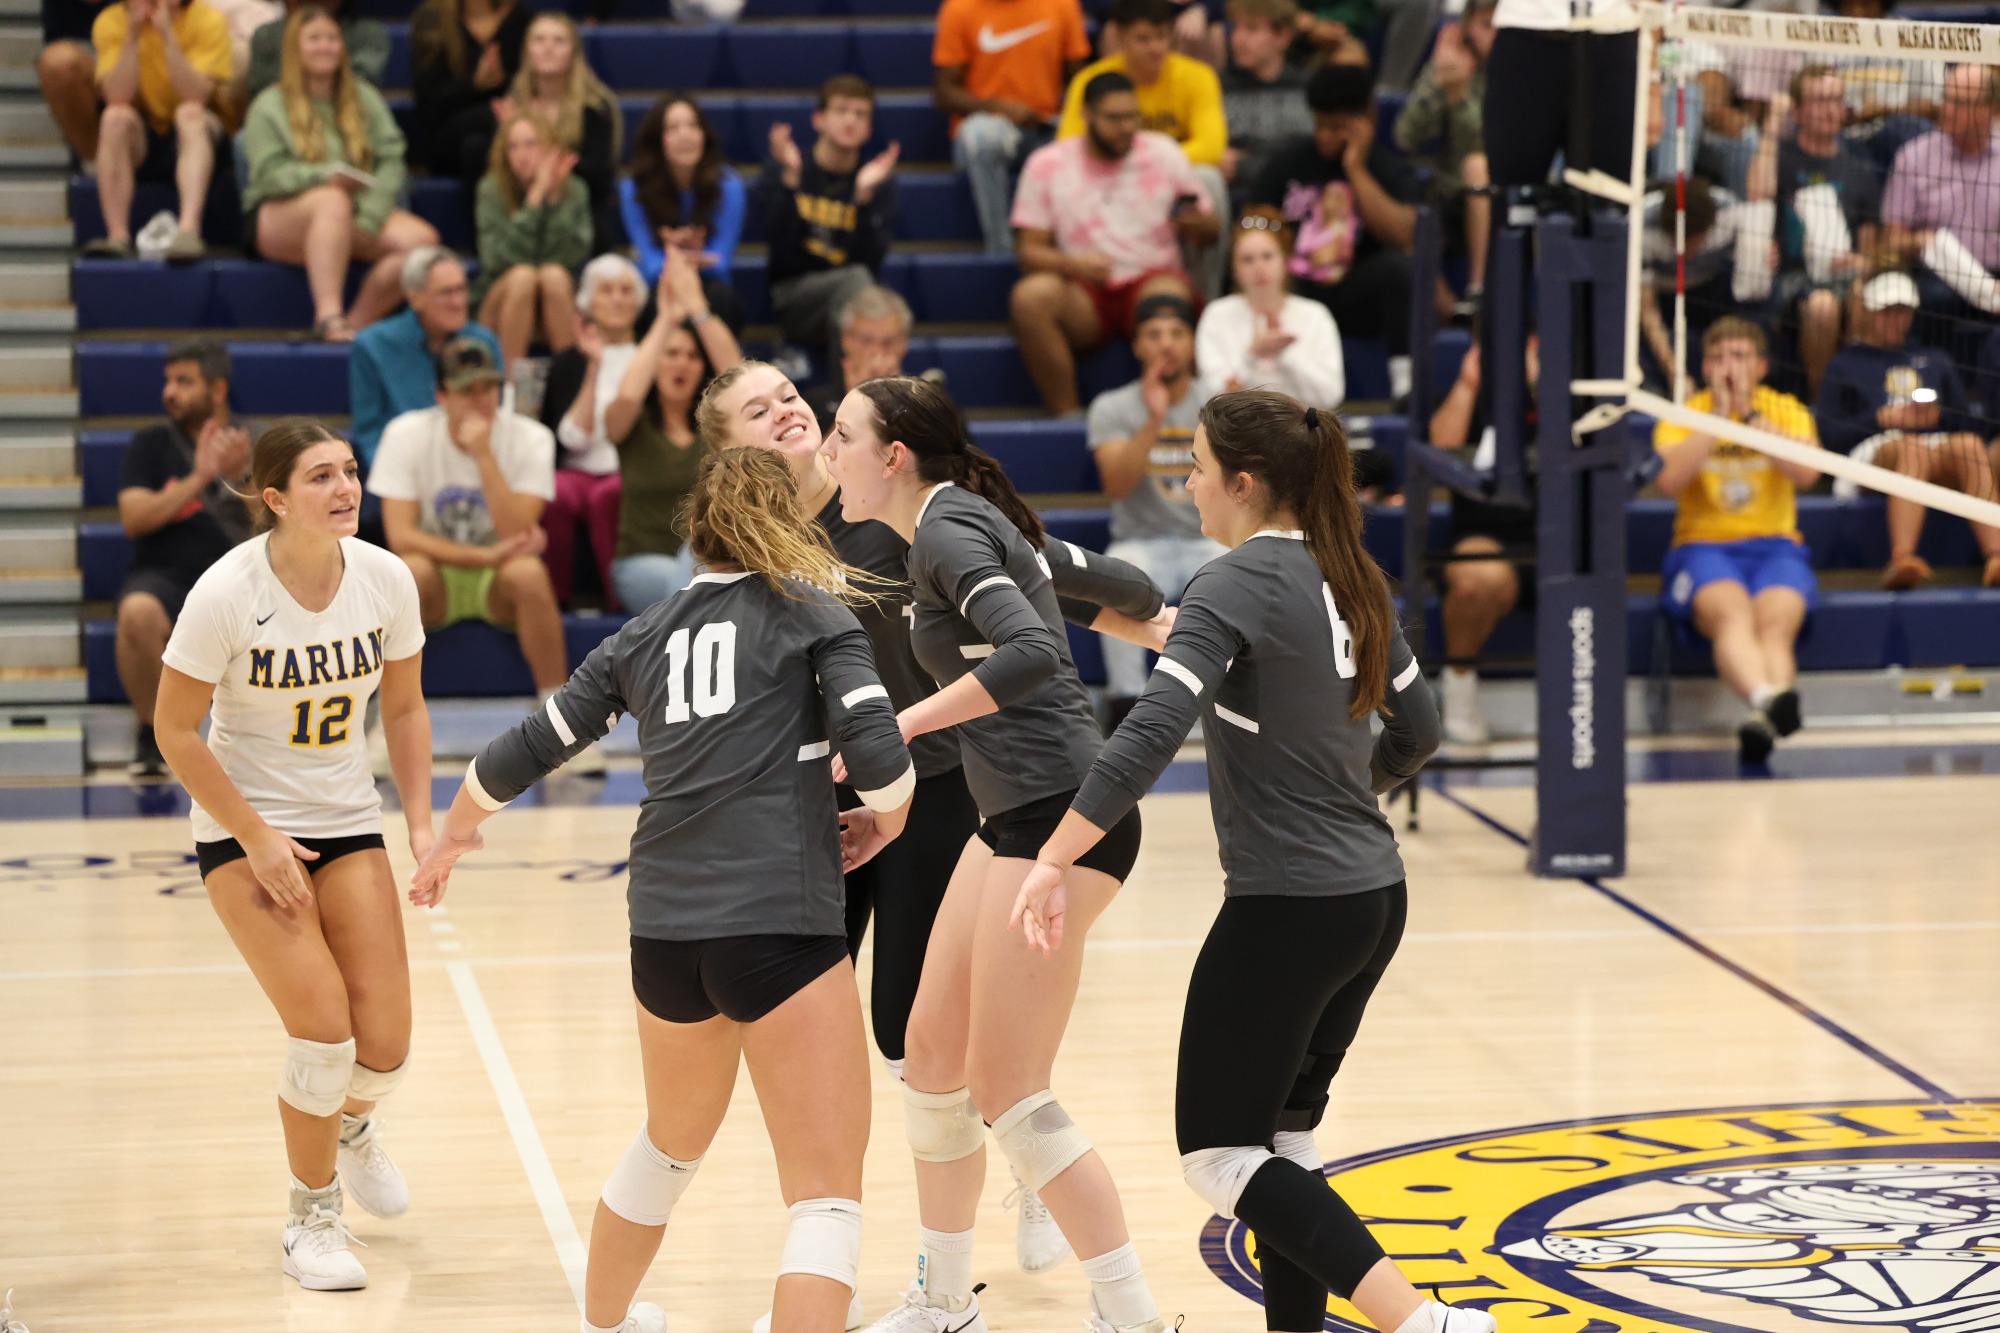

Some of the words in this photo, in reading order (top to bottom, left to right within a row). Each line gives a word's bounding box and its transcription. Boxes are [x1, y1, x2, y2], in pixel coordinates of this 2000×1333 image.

[248, 626, 384, 689] MARIAN
[664, 620, 737, 725] 10
[288, 692, 355, 748] 12
